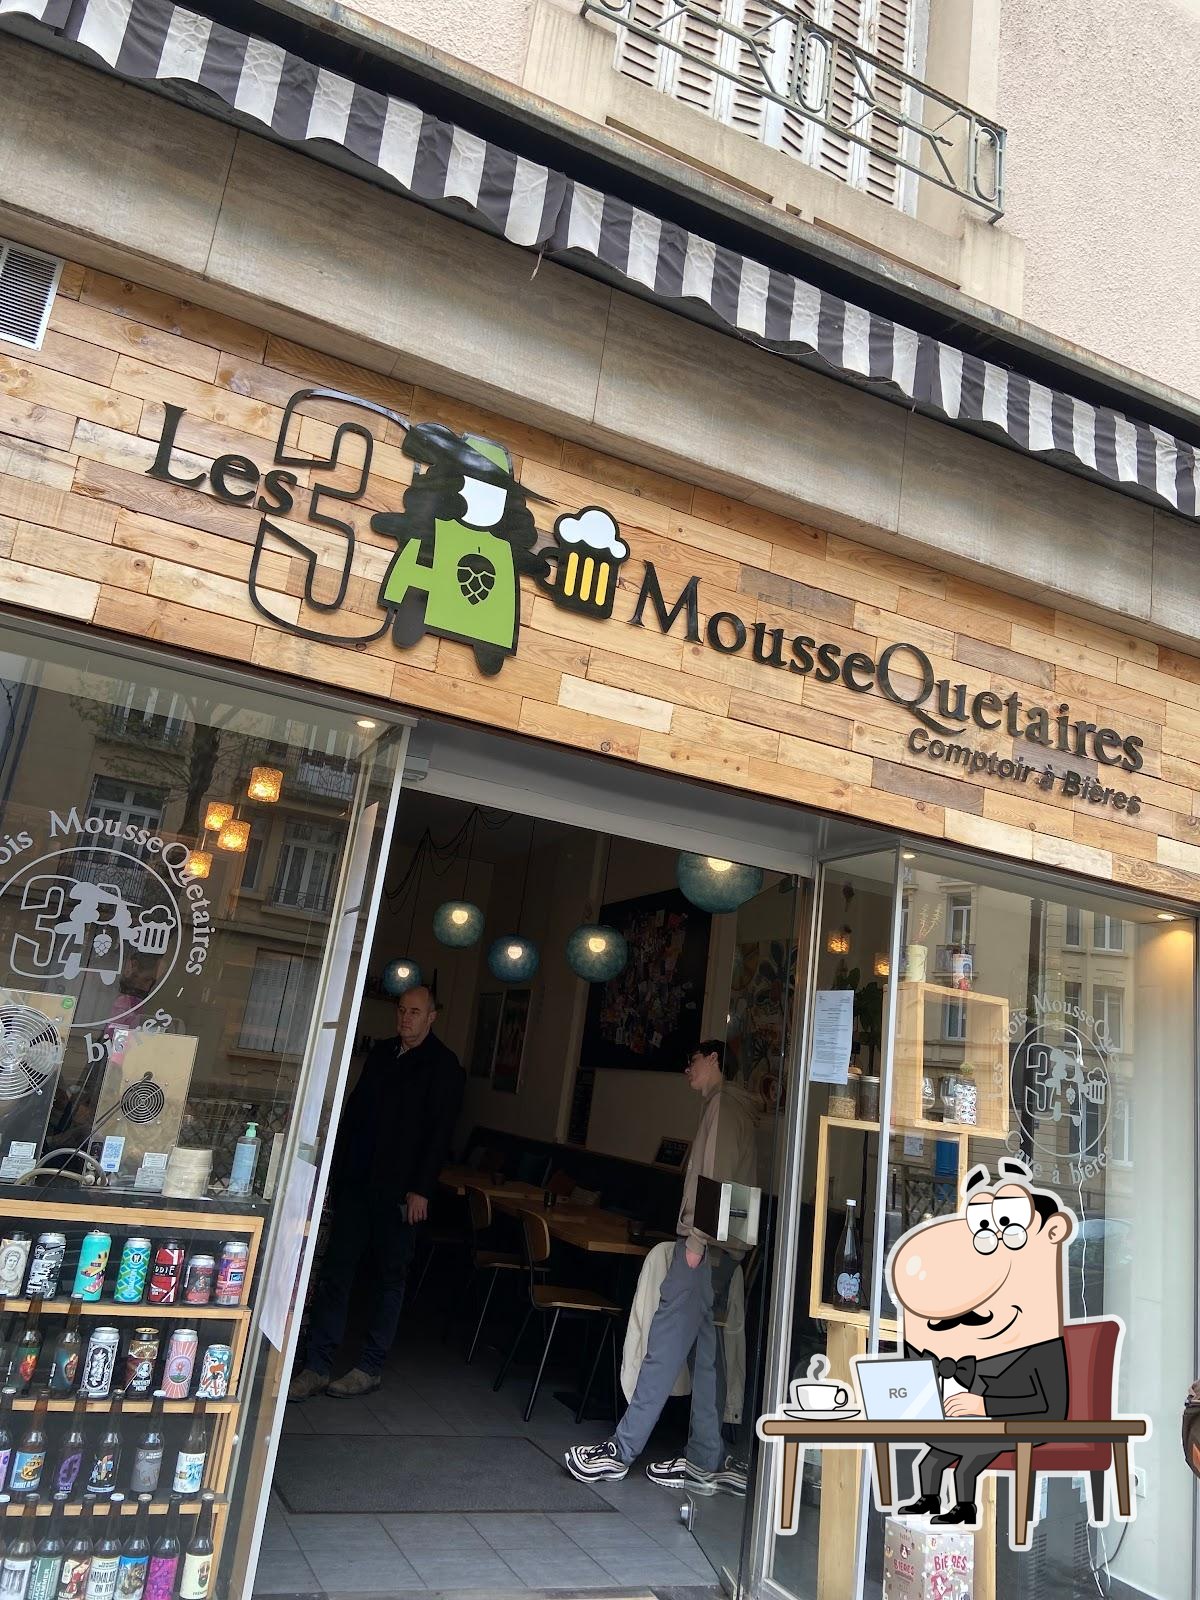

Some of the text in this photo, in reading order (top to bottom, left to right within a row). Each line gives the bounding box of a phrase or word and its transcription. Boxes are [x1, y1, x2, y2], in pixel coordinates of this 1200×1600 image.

[144, 388, 1146, 773] Les 3 MousseQuetaires
[908, 727, 1142, 817] Comptoir à Bières
[0, 831, 33, 865] ois
[48, 806, 216, 977] MousseQuetaires
